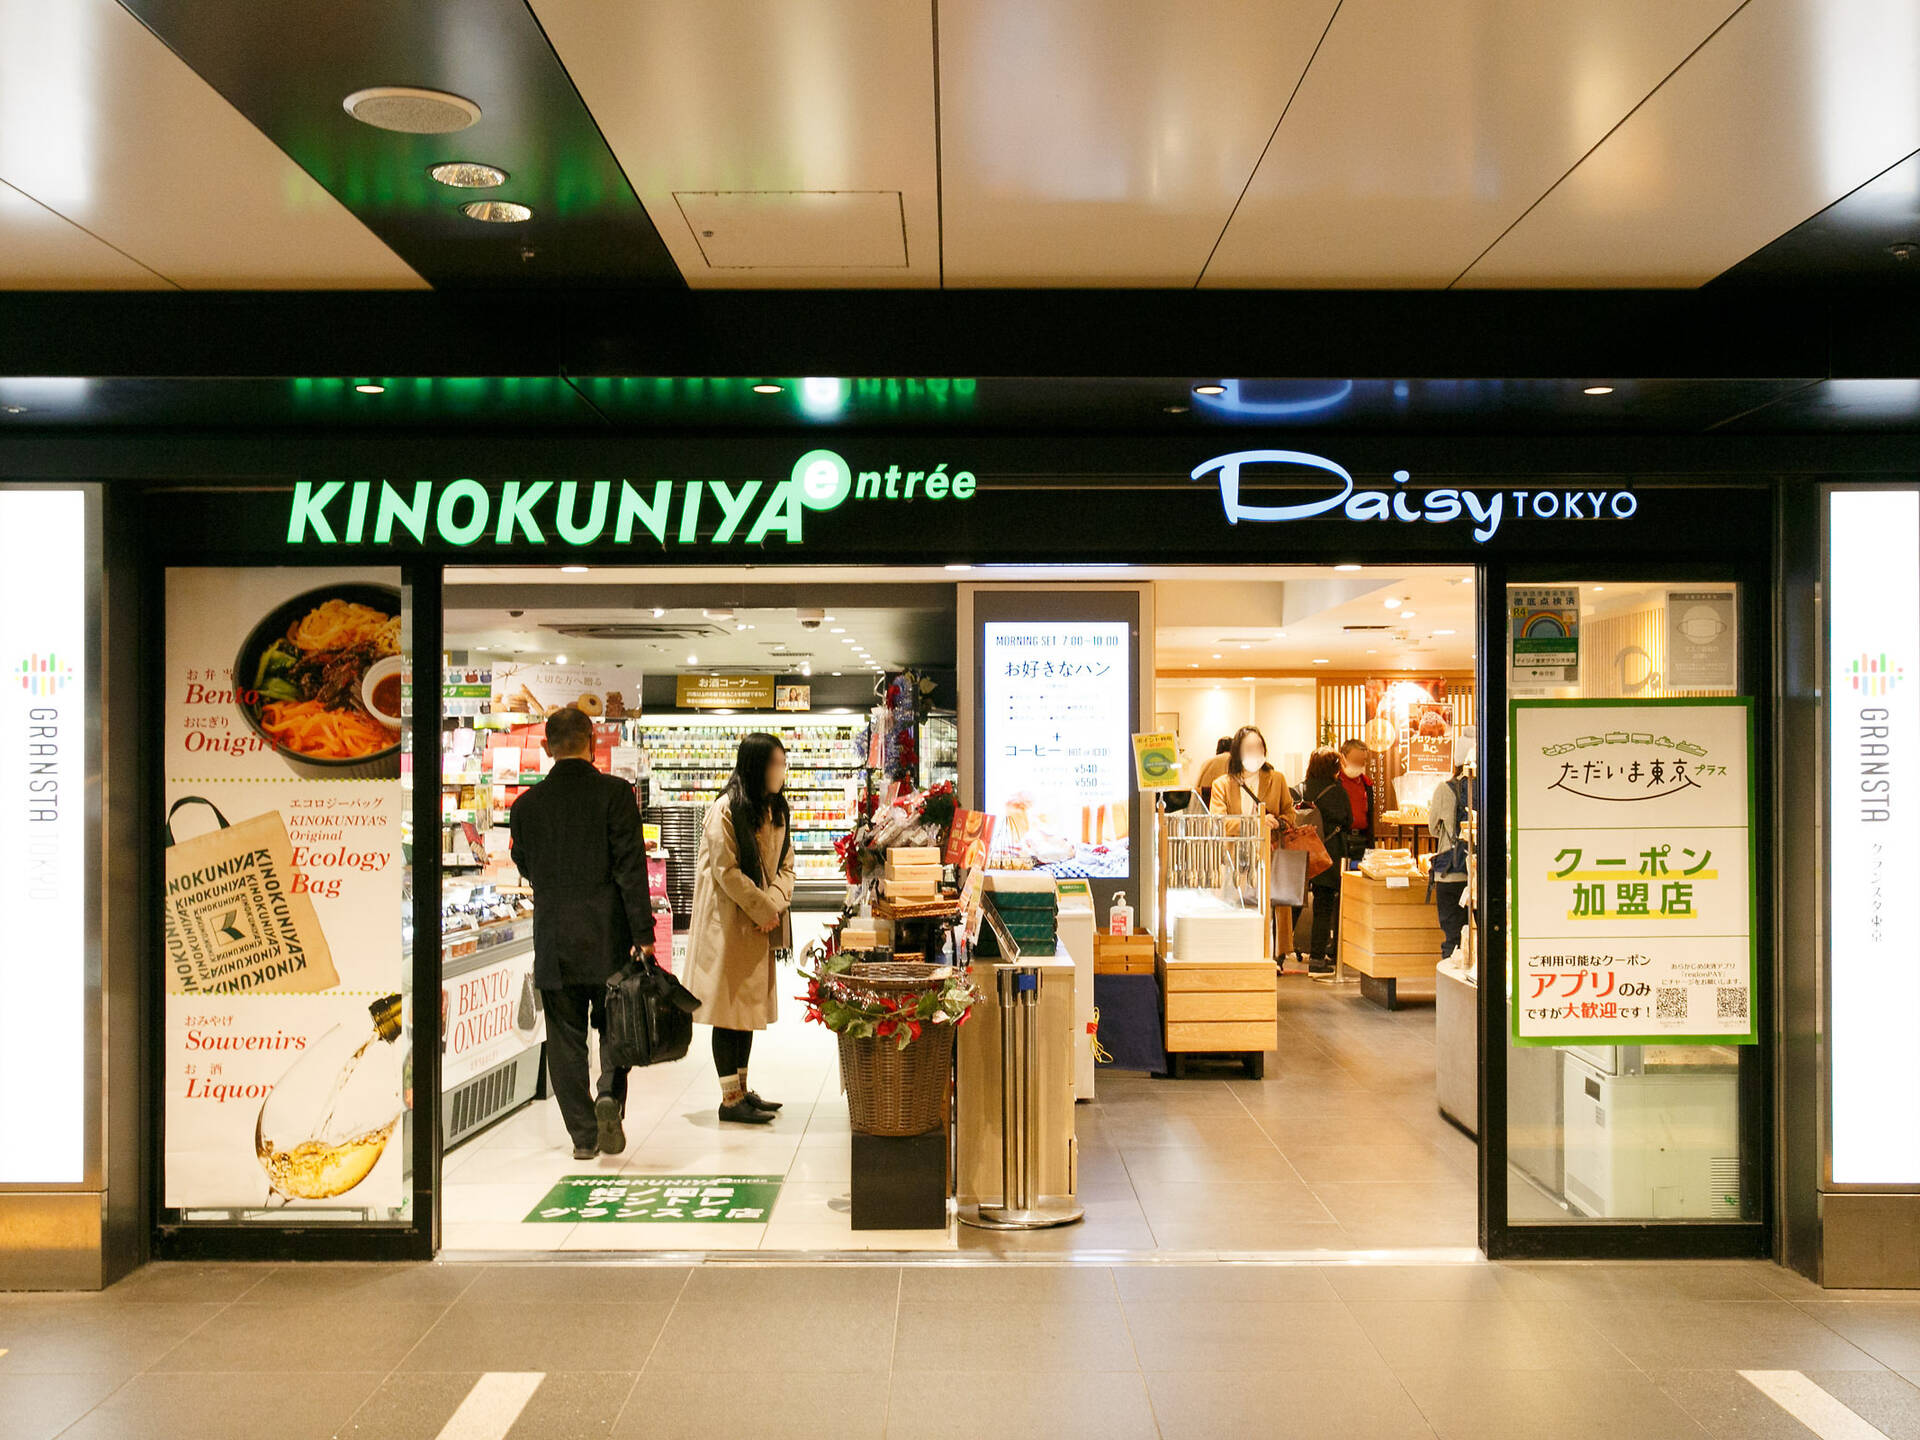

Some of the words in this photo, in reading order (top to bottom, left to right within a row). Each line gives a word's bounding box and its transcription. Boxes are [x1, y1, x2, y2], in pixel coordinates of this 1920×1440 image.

[287, 478, 802, 546] KINOKUNIYA
[793, 450, 976, 508] entrée
[1190, 449, 1502, 543] Daisy
[1513, 491, 1638, 519] TOKYO
[1513, 608, 1526, 616] R4
[996, 635, 1038, 646] MORNING
[184, 683, 259, 705] Bento
[698, 677, 759, 688] お酒コーナー
[184, 716, 229, 729] おにぎり
[1005, 744, 1061, 757] コーヒー
[29, 708, 58, 822] GRANSTA
[1860, 708, 1890, 822] GRANSTA
[290, 797, 383, 809] エコロジーバッグ
[290, 815, 387, 827] KINOKUNIYA'S
[290, 829, 343, 843] Original
[289, 846, 391, 872] Ecology
[1554, 843, 1712, 878] クーポン
[165, 850, 255, 897] NOKUNIYA
[289, 873, 343, 899] Bag
[175, 876, 247, 910] KINOKUNIYA
[254, 848, 303, 954] KINOKUNIYA
[1572, 881, 1693, 916] 加盟店
[246, 873, 280, 946] KINOKUNIYA
[178, 907, 212, 981] KINOKUNIYA
[210, 945, 282, 980] KINOKUNIYA
[1528, 954, 1652, 968] ご利用可能なクーポン
[458, 968, 510, 1016] BENTO
[184, 1015, 234, 1027] おみやげ
[454, 1000, 514, 1054] ONIGIRI
[184, 1029, 307, 1051] Souvenirs
[184, 1078, 275, 1103] Liquor
[571, 1178, 719, 1187] KINOKUNIYA
[540, 1206, 764, 1219] グランスタ店
[586, 1196, 731, 1207] アントレ
